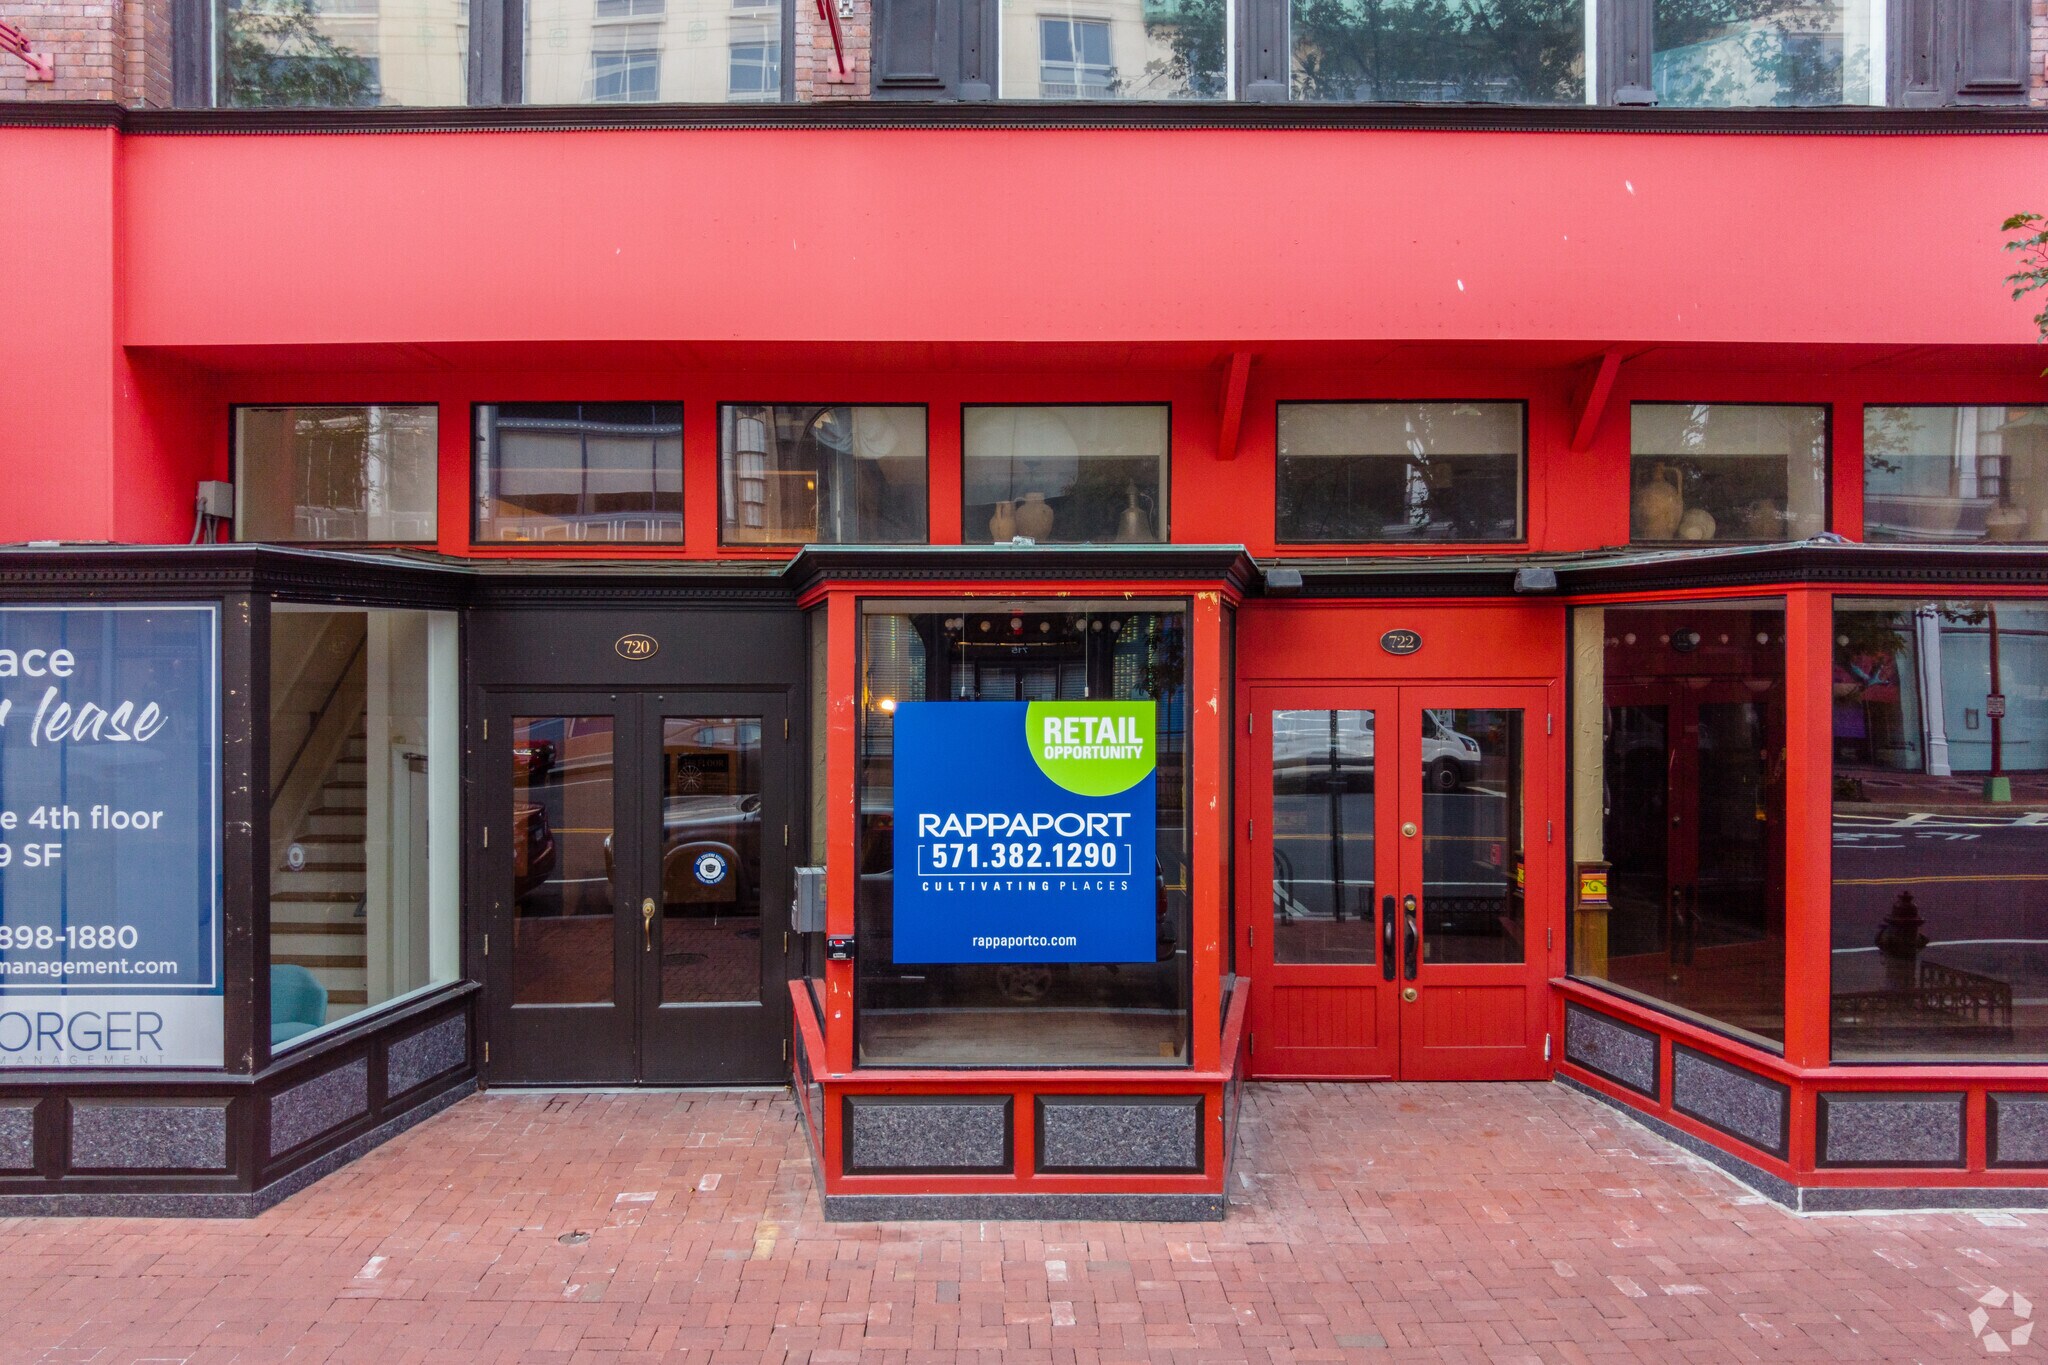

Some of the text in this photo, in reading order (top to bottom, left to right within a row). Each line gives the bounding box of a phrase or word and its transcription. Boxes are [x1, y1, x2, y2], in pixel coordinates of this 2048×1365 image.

[624, 640, 650, 653] 720
[1389, 635, 1414, 648] 722
[0, 649, 75, 677] ace
[31, 686, 168, 747] lease
[1043, 717, 1143, 744] RETAIL
[1044, 746, 1143, 759] OPPORTUNITY
[0, 804, 163, 829] e 4th floor
[919, 813, 1131, 837] RAPPAPORT
[23, 843, 62, 867] SF
[932, 843, 1117, 868] 571.382.1290
[922, 881, 1128, 891] CULTIVATING PLACES
[0, 925, 138, 949] 898-1880
[973, 935, 1077, 949] rappaportco.com
[0, 1011, 163, 1051] ORGER
